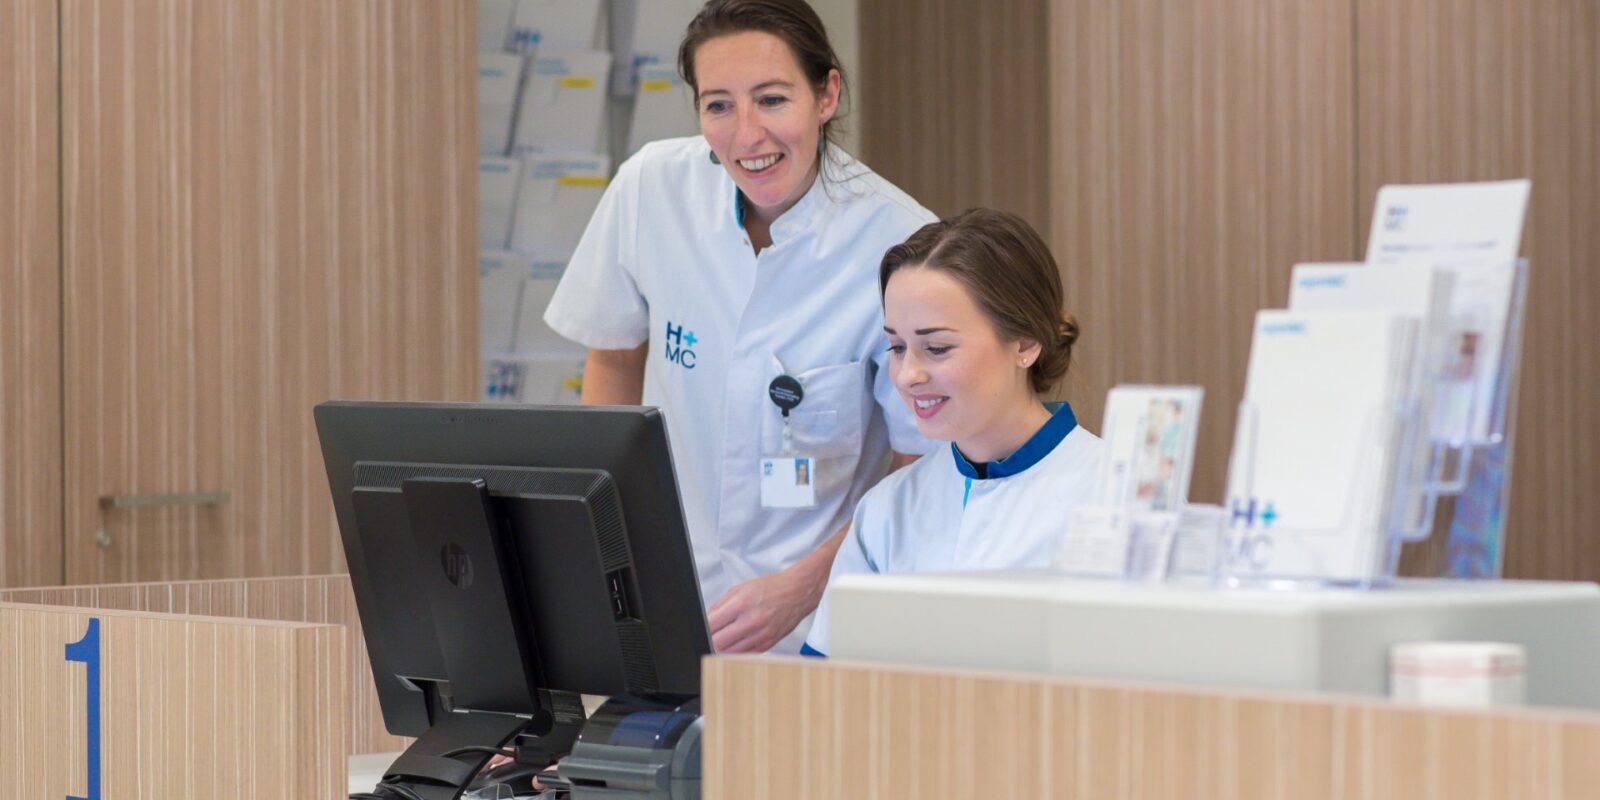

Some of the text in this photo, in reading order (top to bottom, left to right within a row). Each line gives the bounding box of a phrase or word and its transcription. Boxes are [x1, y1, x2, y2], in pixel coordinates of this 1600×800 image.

[665, 341, 696, 369] MC
[446, 543, 474, 590] hp
[65, 617, 100, 800] 1
